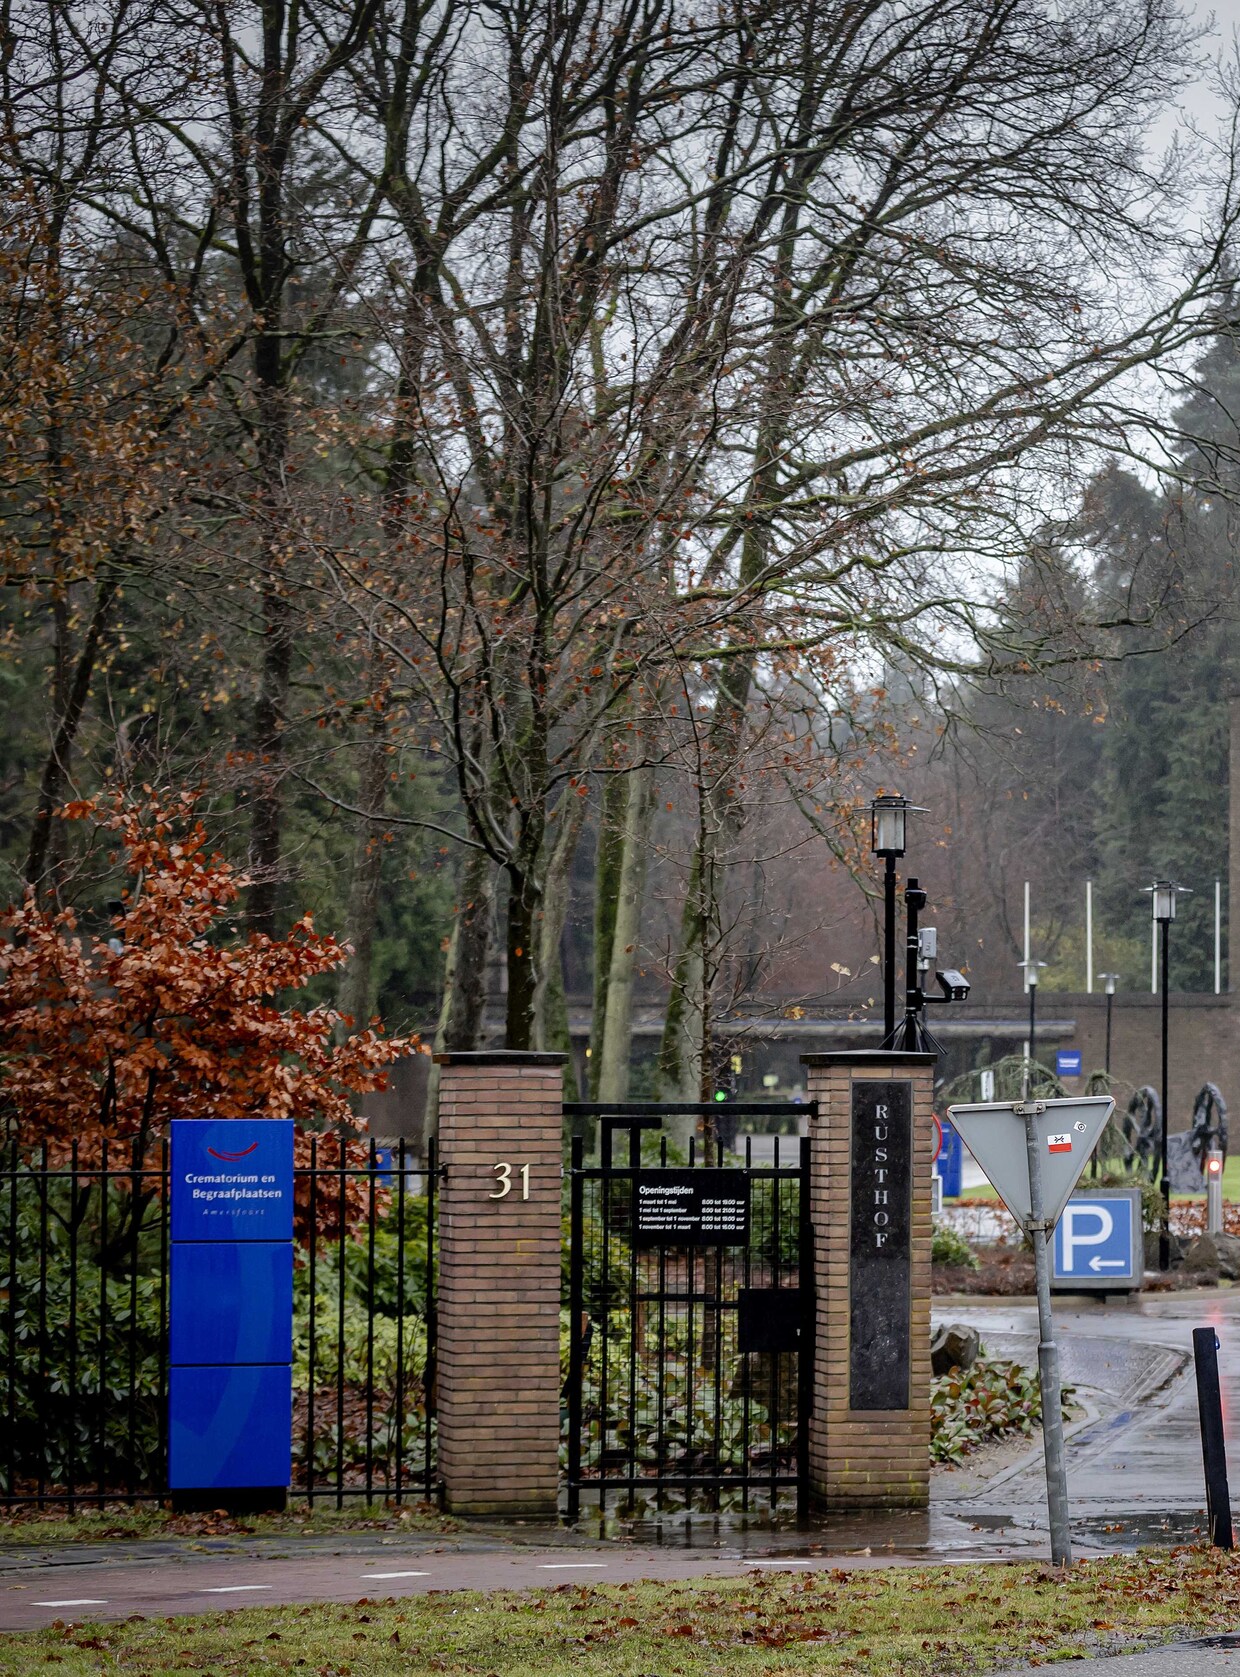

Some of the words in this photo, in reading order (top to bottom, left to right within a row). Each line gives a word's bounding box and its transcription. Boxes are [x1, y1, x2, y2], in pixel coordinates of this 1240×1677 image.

[185, 1173, 258, 1184] Crematorium
[261, 1175, 276, 1183] en
[489, 1162, 530, 1200] 31
[874, 1104, 889, 1248] RUSTHOF
[192, 1188, 282, 1201] Begraafplaatsen
[639, 1185, 694, 1196] Openingstijden
[1062, 1205, 1113, 1272] P
